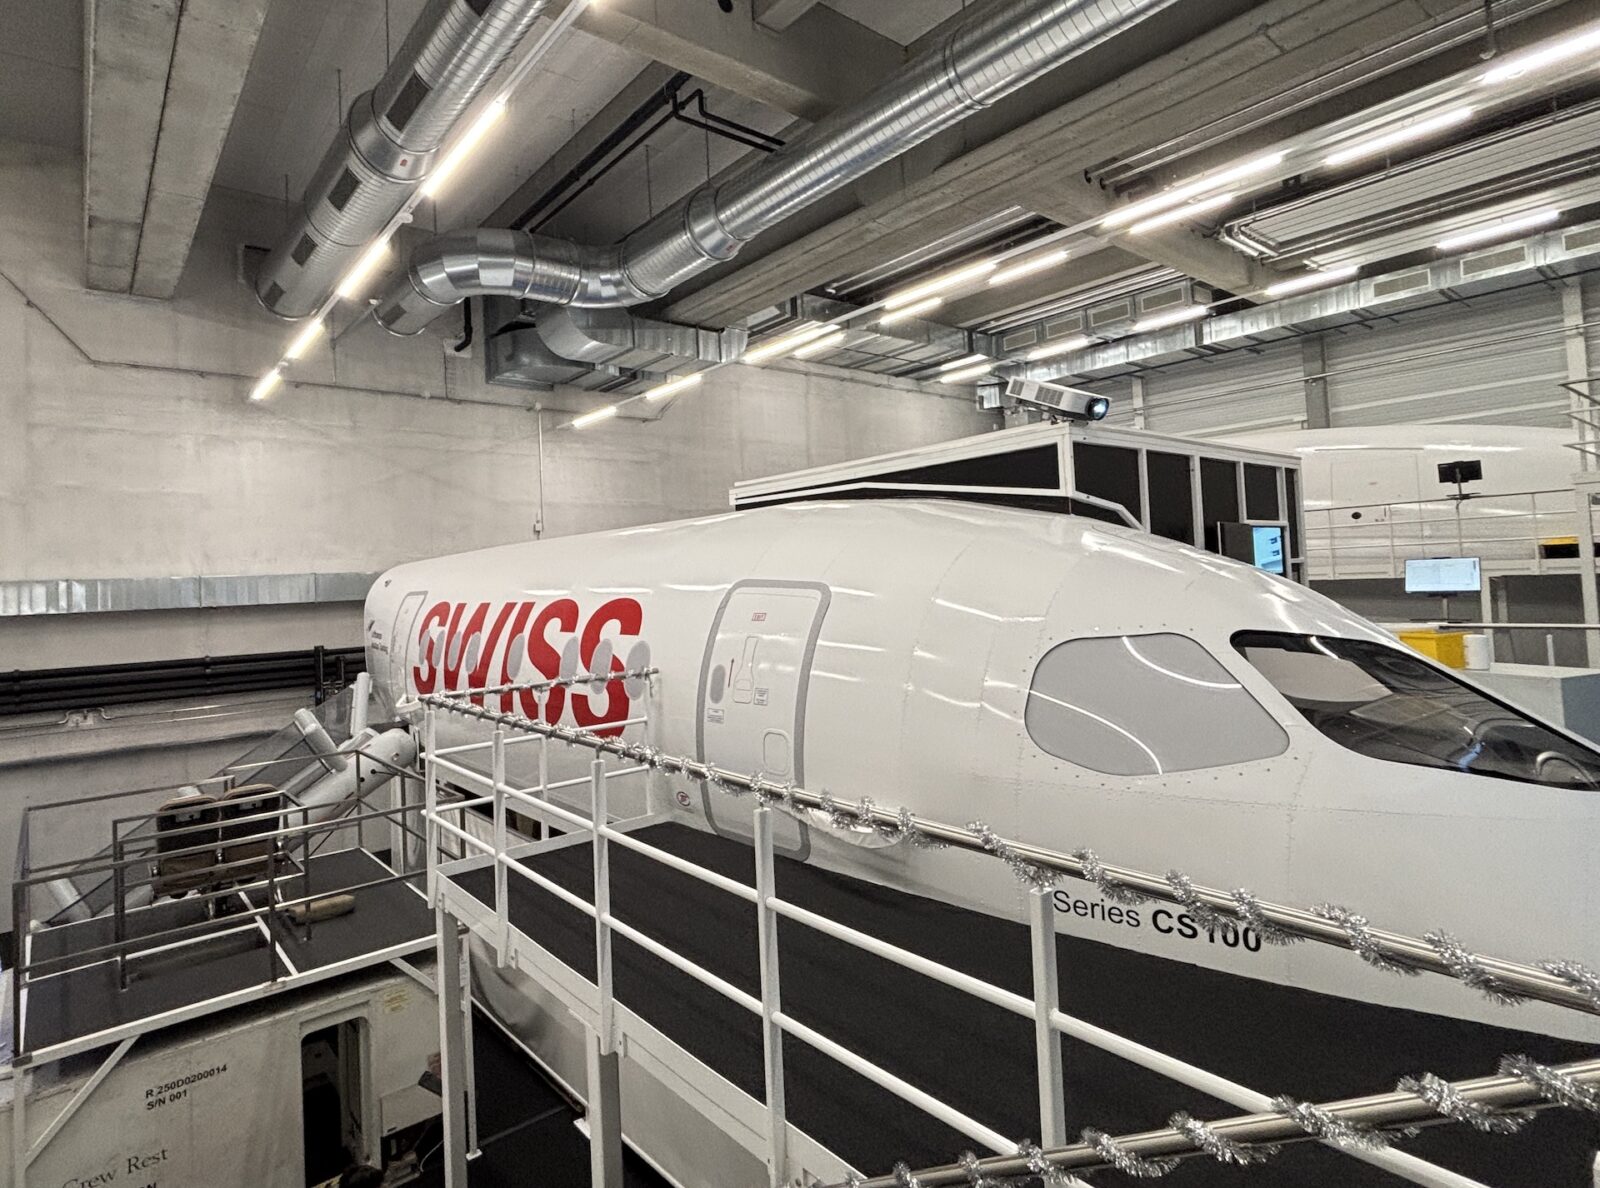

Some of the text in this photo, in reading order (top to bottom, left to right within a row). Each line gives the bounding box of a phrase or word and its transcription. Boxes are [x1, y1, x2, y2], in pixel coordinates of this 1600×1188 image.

[413, 598, 643, 738] SWISS
[1053, 890, 1141, 928] Series
[157, 1064, 227, 1095] 250D0200014
[146, 1089, 187, 1110] S/N 001
[127, 1149, 168, 1174] Rest
